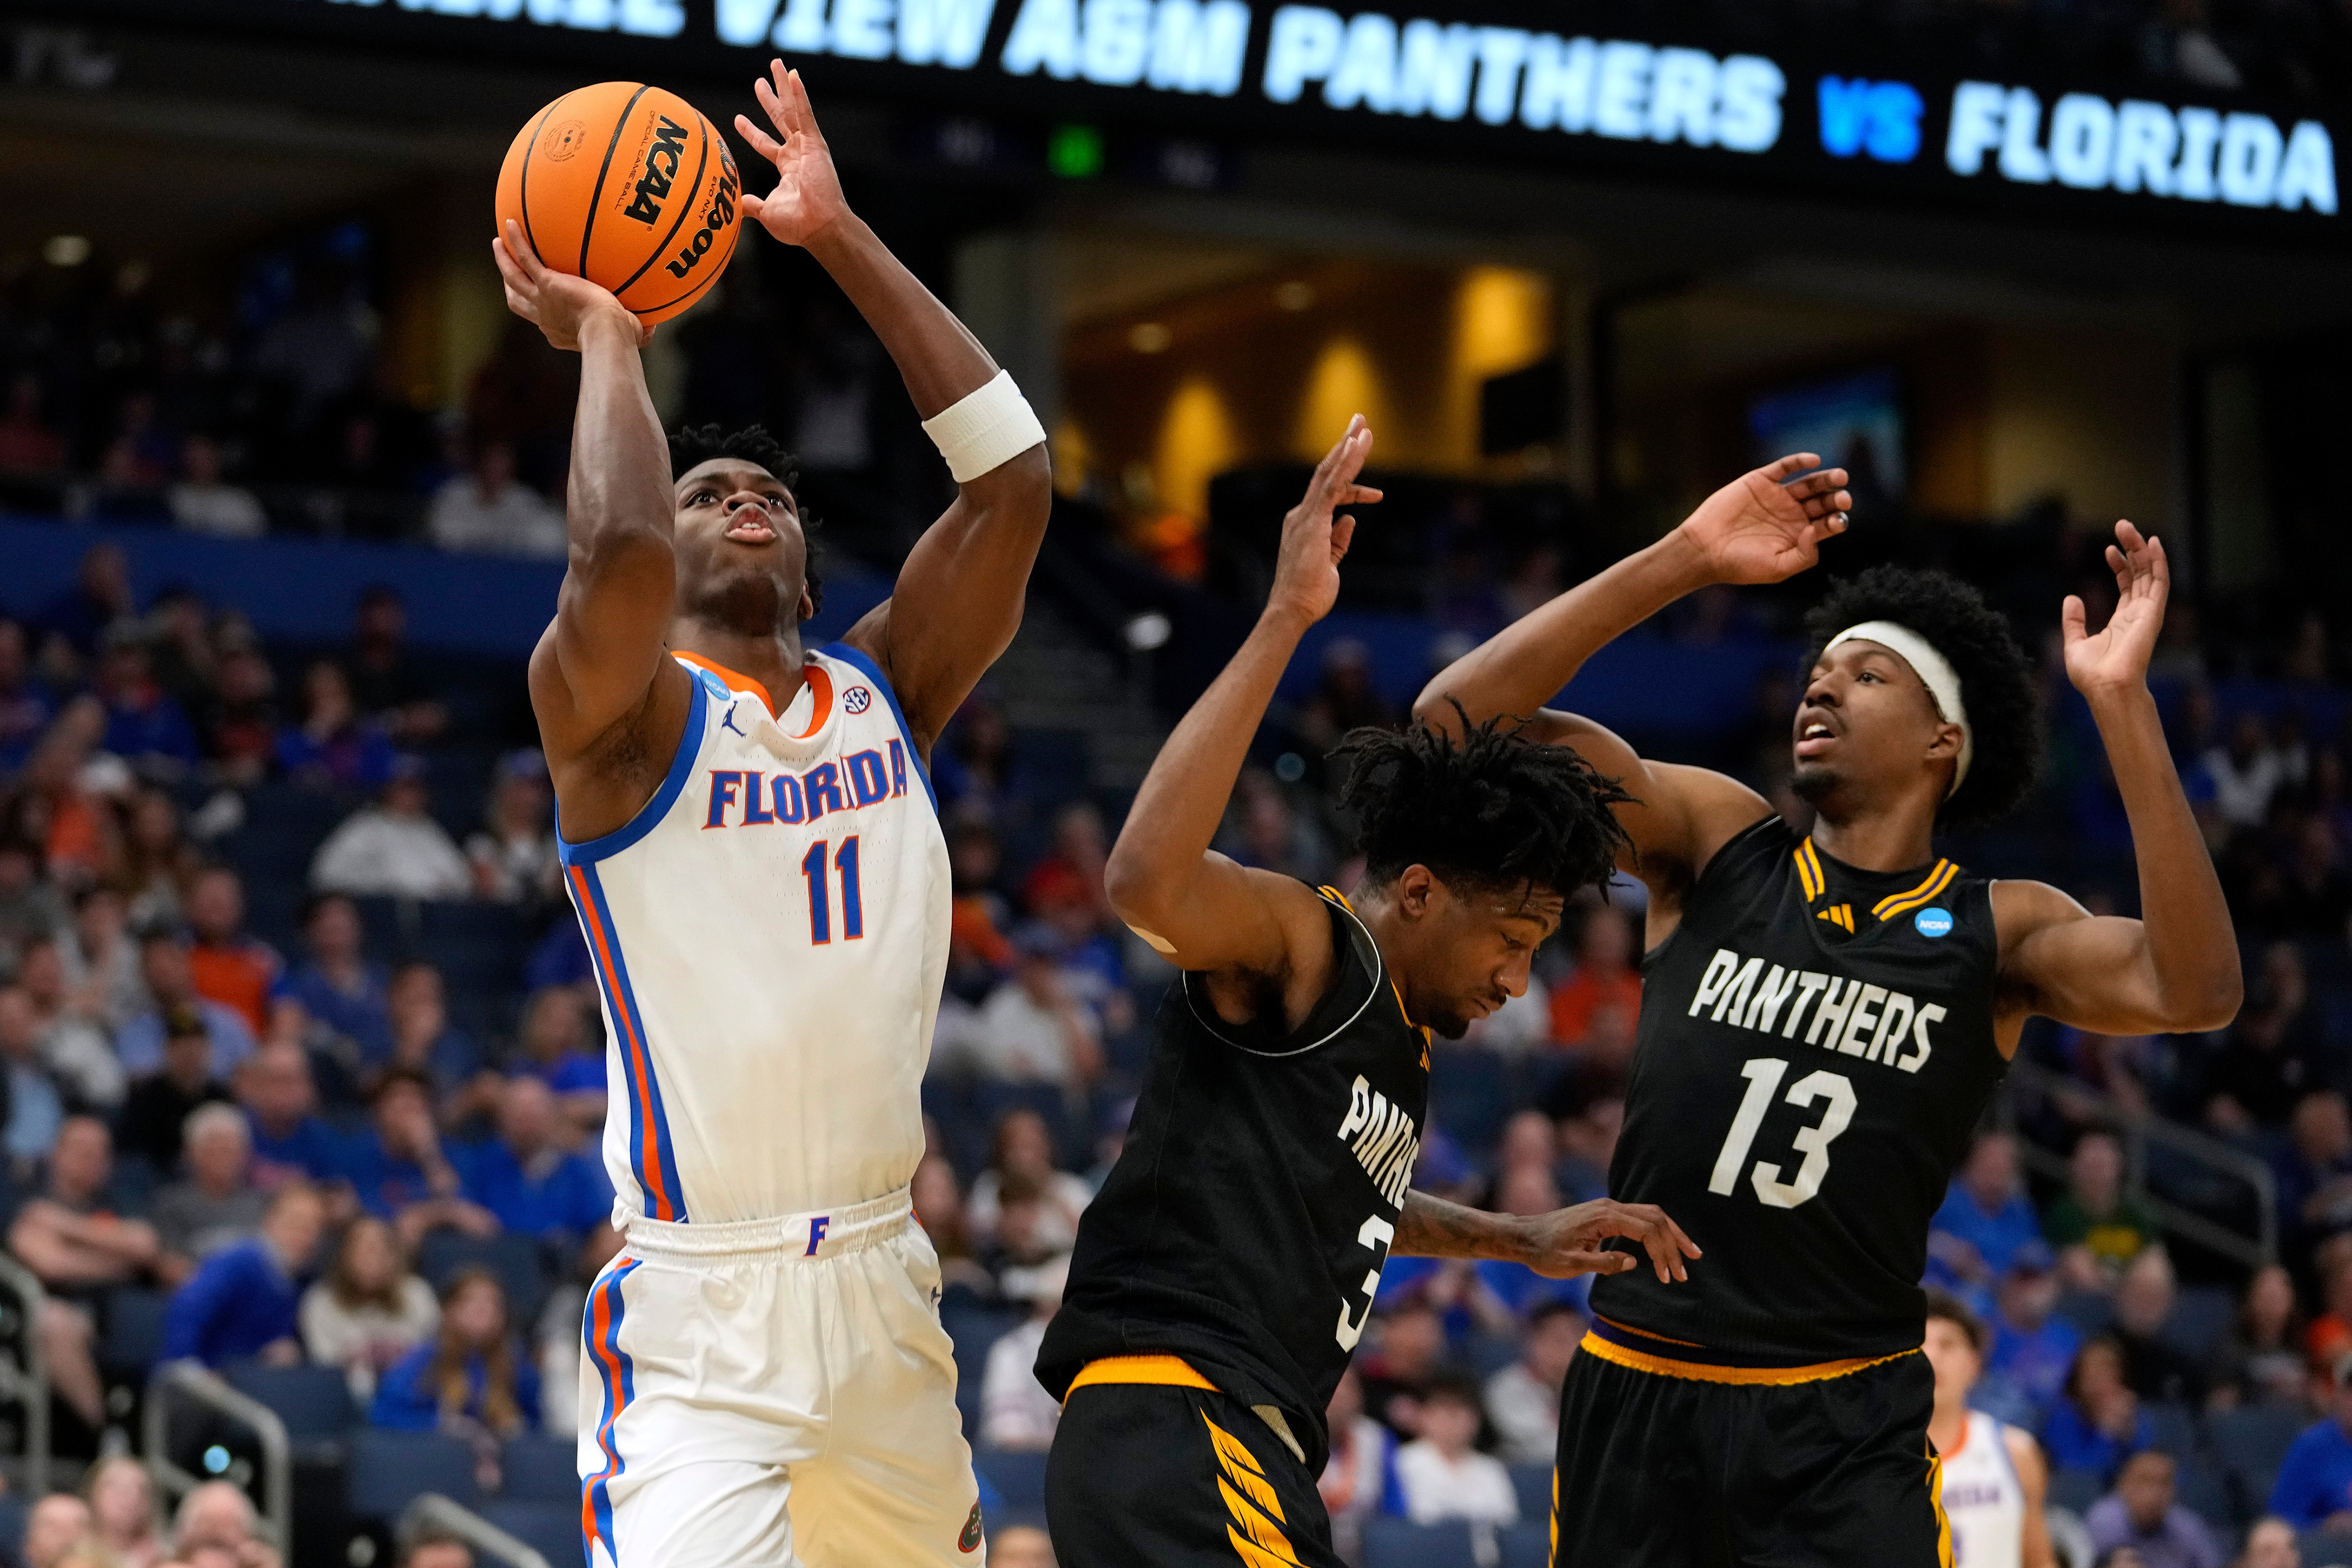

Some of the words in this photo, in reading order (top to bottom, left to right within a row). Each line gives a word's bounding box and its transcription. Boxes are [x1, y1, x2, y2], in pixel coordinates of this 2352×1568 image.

[1001, 0, 1251, 95] A&M
[1263, 4, 1786, 152] PANTHERS
[1817, 76, 1924, 162] VS
[1948, 81, 2338, 214] FLORIDA
[614, 181, 632, 211] BALL
[624, 114, 689, 226] NCAA
[628, 149, 645, 180] GAME
[708, 176, 717, 197] EVO
[664, 138, 738, 279] Wilson
[698, 199, 710, 221] NXT
[844, 688, 869, 712] SEC
[802, 834, 864, 946] 11
[1919, 920, 1950, 930] NCAA
[1688, 949, 1948, 1074] PANTHERS
[1708, 1057, 1858, 1208] 13
[802, 1215, 830, 1258] F
[1336, 1214, 1394, 1353] 3
